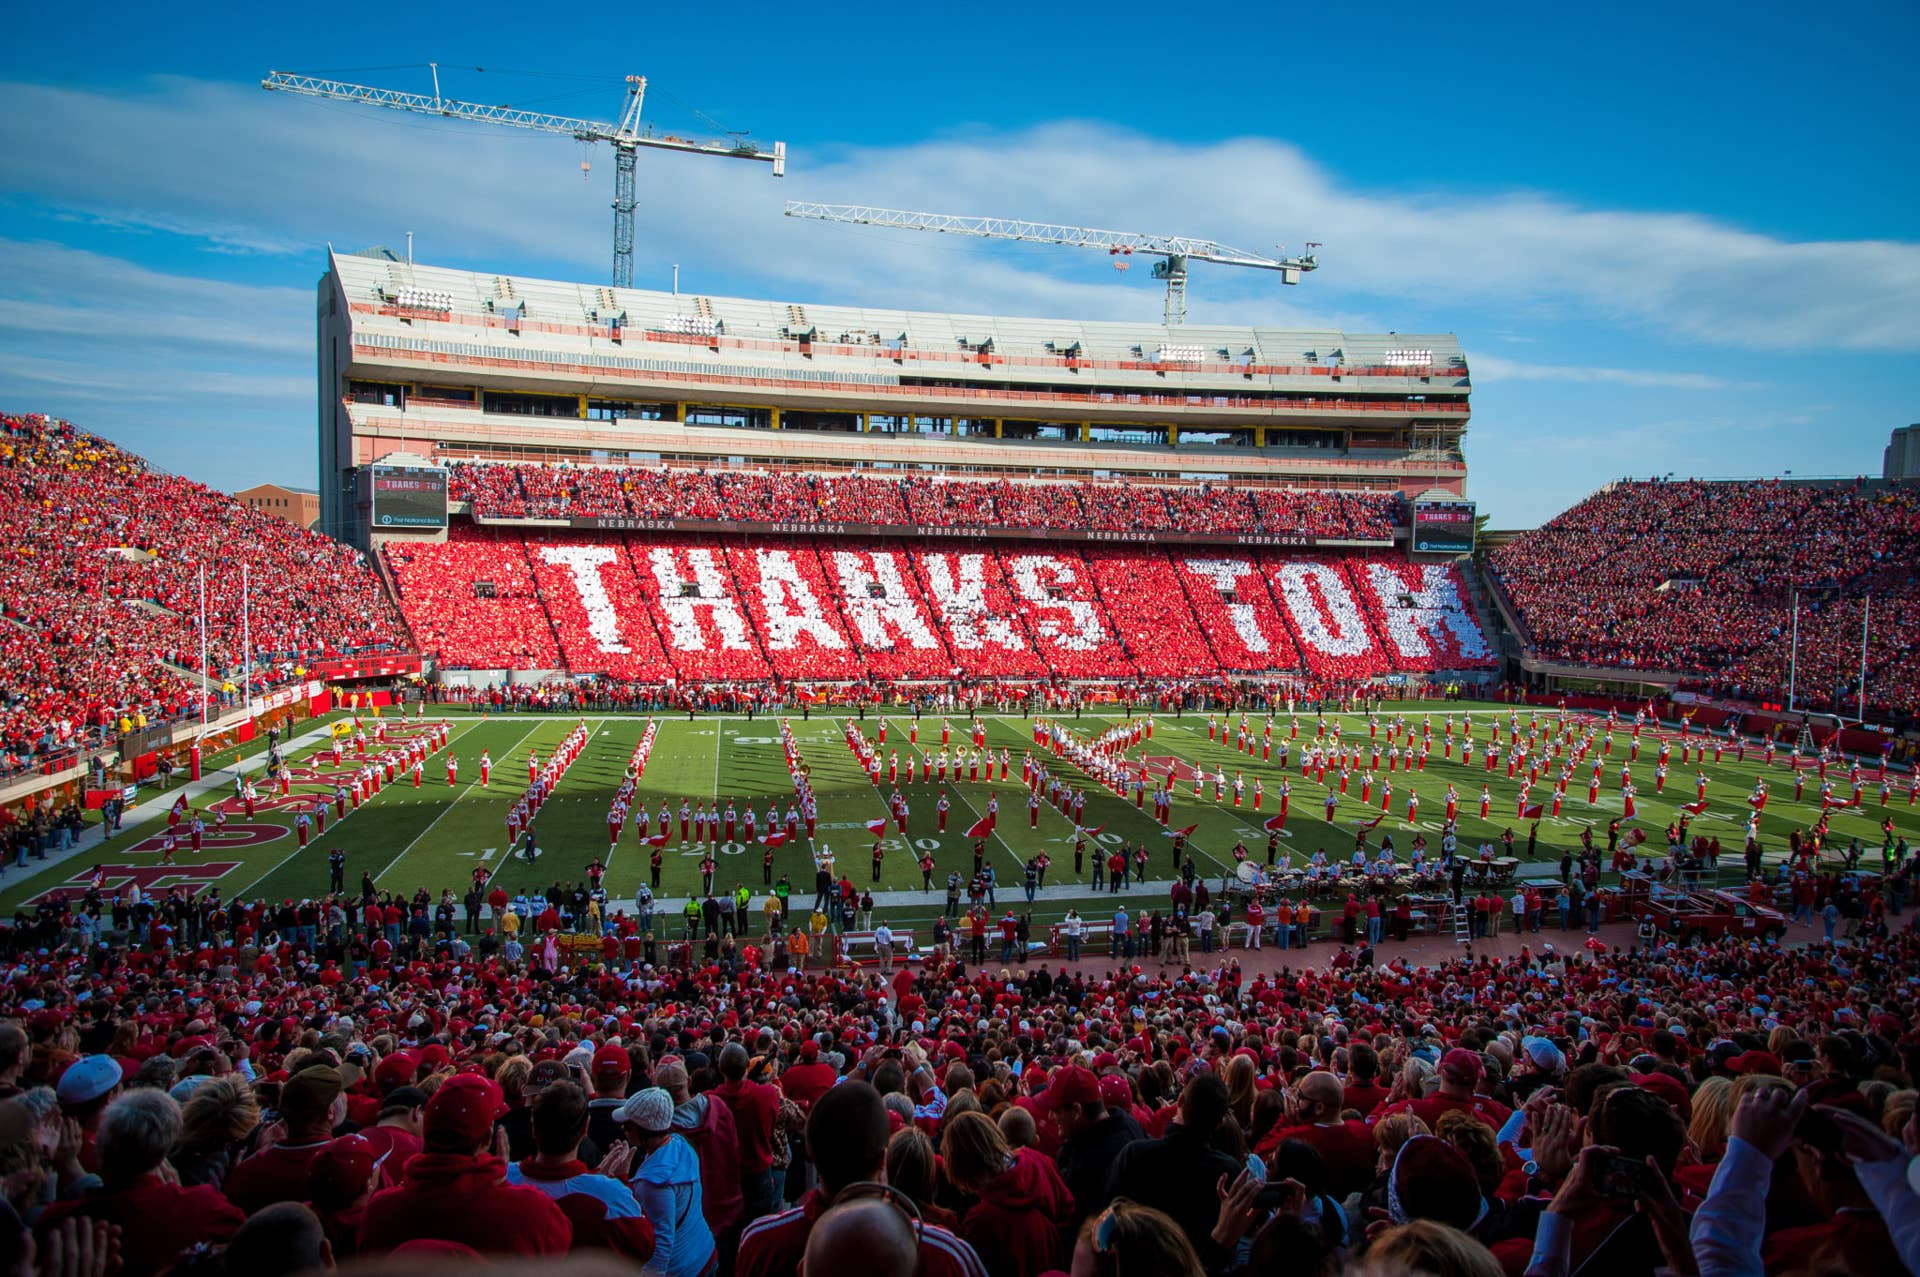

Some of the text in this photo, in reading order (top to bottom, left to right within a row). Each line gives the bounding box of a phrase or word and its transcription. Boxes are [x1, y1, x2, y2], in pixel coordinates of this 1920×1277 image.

[597, 518, 676, 530] NEBRASKA
[772, 522, 845, 534] NEBRASKA
[917, 526, 987, 537] NEBRASKA
[1087, 531, 1155, 541] NEBRASKA
[1238, 535, 1306, 545] NEBRASKA
[538, 546, 1492, 659] THANKS TOM
[1863, 723, 1894, 735] verizon
